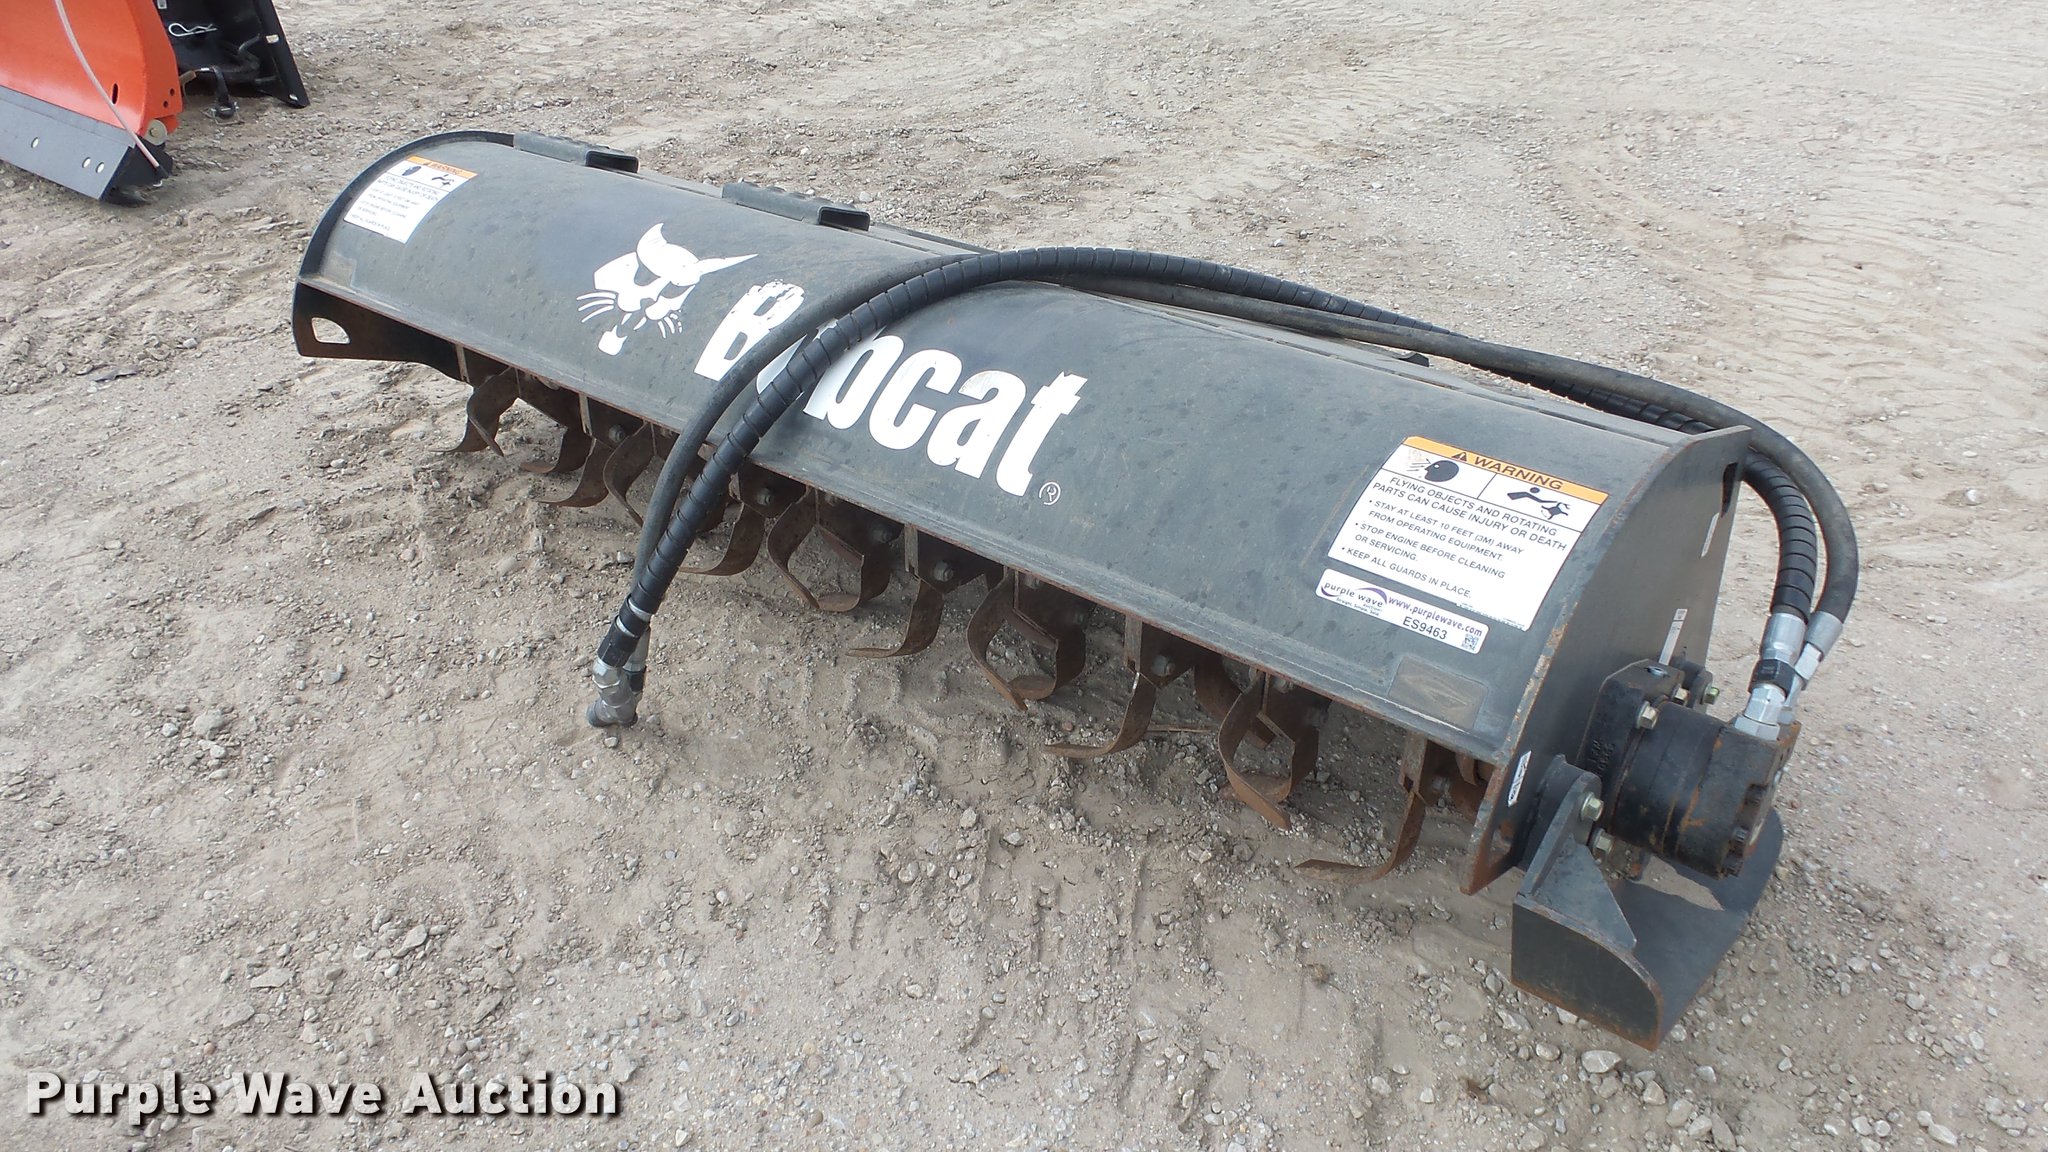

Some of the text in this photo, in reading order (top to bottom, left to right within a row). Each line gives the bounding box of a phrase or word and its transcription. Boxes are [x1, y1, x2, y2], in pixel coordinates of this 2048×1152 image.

[694, 279, 1088, 497] Bbcat
[1474, 456, 1564, 490] WARNING
[1373, 482, 1568, 551] PARTS CAN CAUSE INJURY OR DEATH
[1374, 500, 1397, 511] STAY
[1410, 512, 1438, 526] LEAST
[1440, 522, 1450, 530] 10
[1451, 525, 1474, 538] FEET
[1496, 541, 1524, 555] AWAY
[1390, 477, 1557, 536] FLYING OBJECTS AND ROTATING
[1355, 534, 1418, 562] OR SERVICING.
[1360, 523, 1506, 579] STOP ENGINE BEFORE CLEANING
[1368, 510, 1503, 561] FROM OPERATING EQUIPMENT.
[1324, 581, 1355, 598] purple
[1358, 593, 1383, 608] wave
[1346, 547, 1471, 599] KEEP ALL GUARDS IN PLACE.
[1388, 597, 1483, 637] www.purplewave.com
[1402, 616, 1448, 640] ES9463
